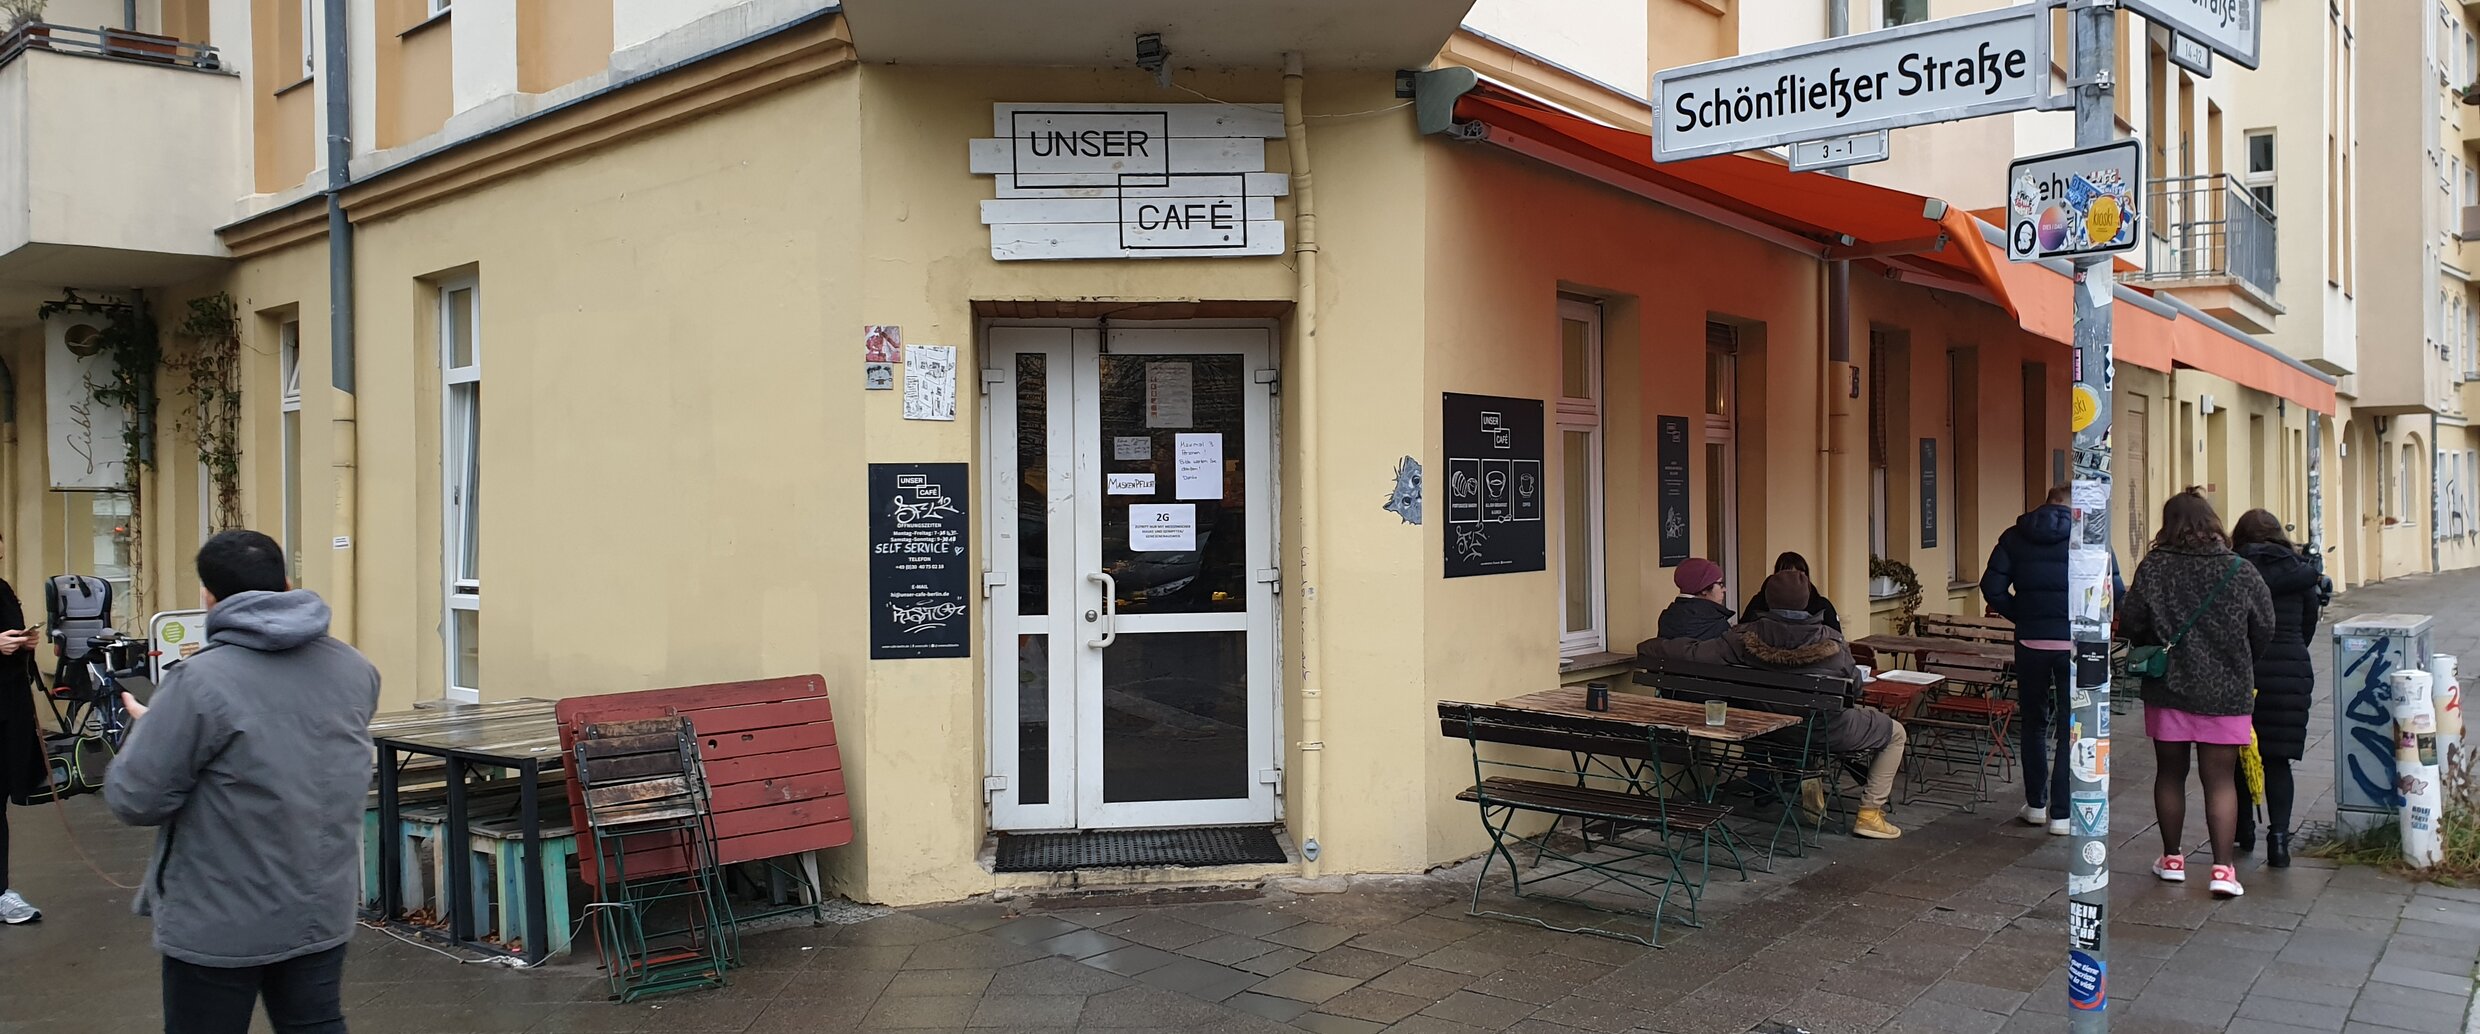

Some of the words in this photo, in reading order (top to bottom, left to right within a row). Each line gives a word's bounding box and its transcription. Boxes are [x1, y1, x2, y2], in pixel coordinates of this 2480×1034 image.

[2192, 0, 2236, 28] aße
[1675, 68, 1889, 133] Schönfließer
[1898, 41, 2027, 96] Straße
[1030, 130, 1149, 157] UNSER
[1138, 200, 1234, 230] CAFÉ
[1483, 416, 1499, 426] UNSER
[1496, 434, 1509, 444] CAFÉ
[919, 487, 938, 496] CAFÉ
[1156, 513, 1170, 522] 2G
[875, 543, 902, 554] SELF
[903, 542, 950, 554] SERVICE
